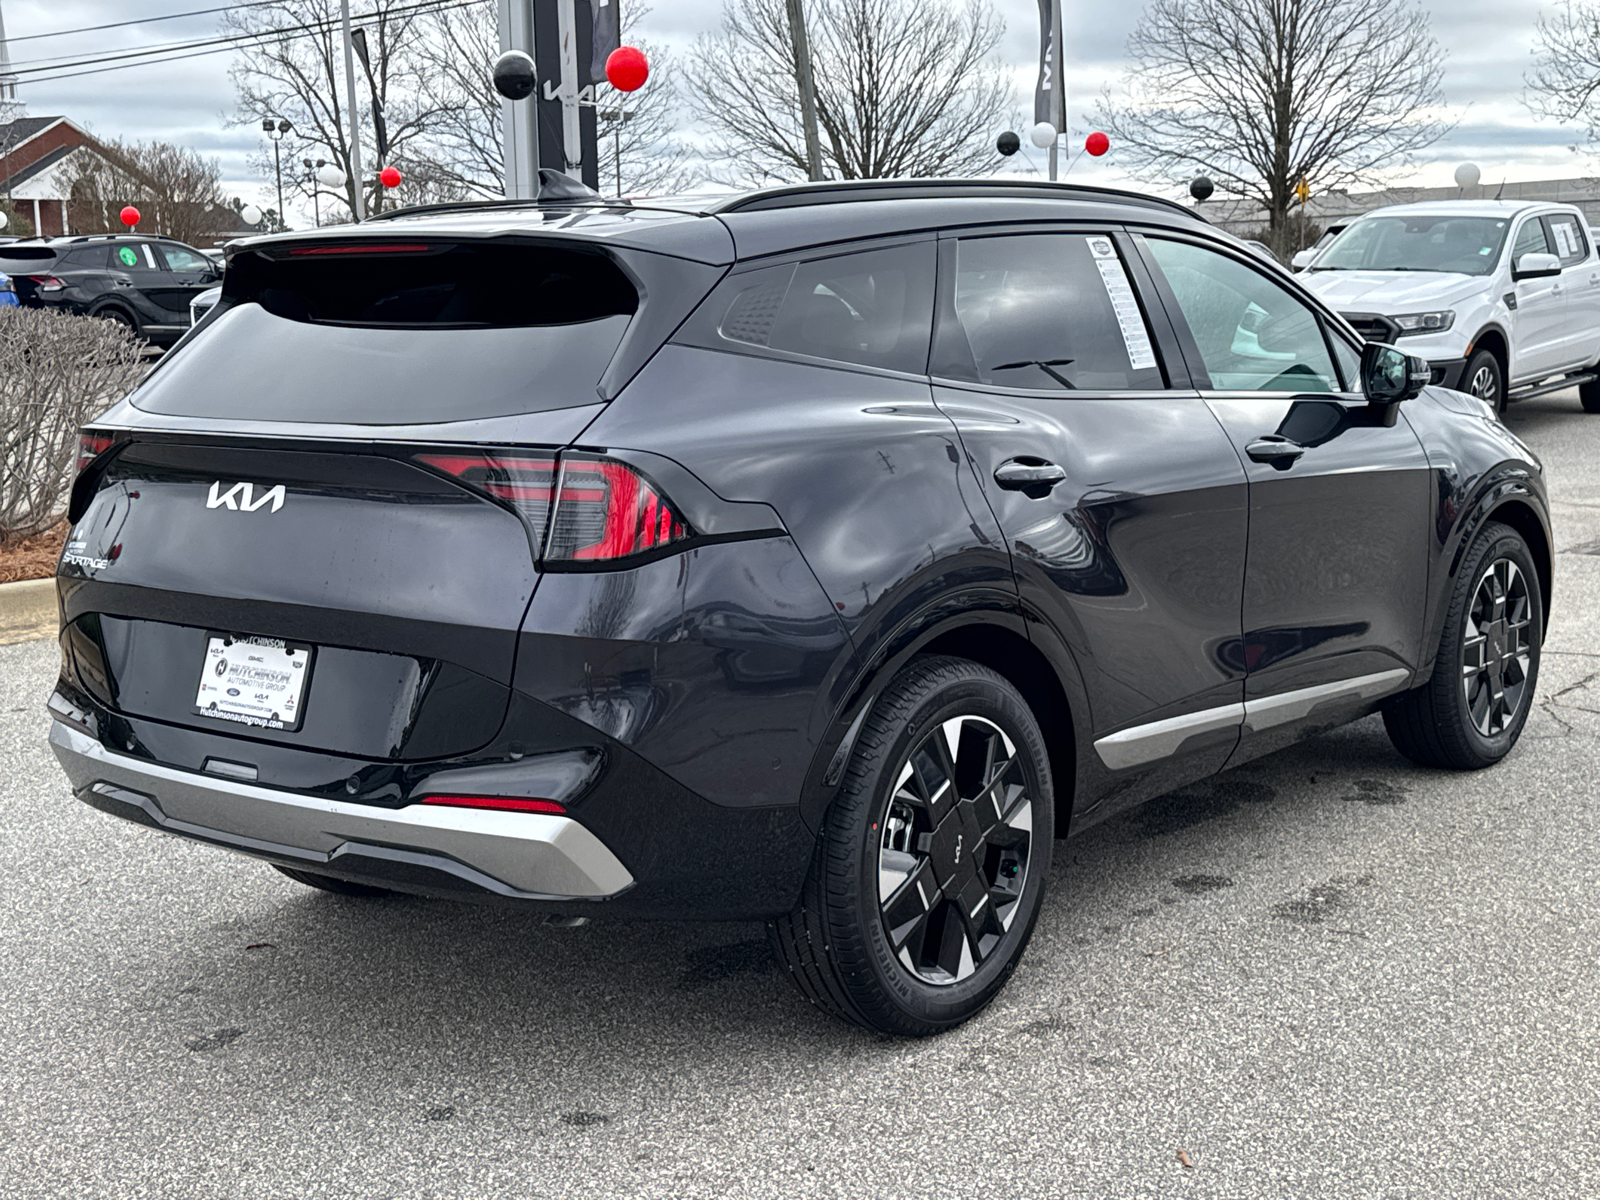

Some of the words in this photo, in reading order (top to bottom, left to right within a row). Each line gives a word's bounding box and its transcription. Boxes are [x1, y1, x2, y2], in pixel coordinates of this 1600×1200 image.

[206, 480, 286, 514] KIA
[62, 551, 108, 570] SPORTAGE
[227, 677, 265, 690] AUTOMOTIVE
[265, 682, 286, 692] GROUP
[199, 706, 284, 730] Hutchinsonautogroup.com
[869, 923, 910, 998] MICHELIN
